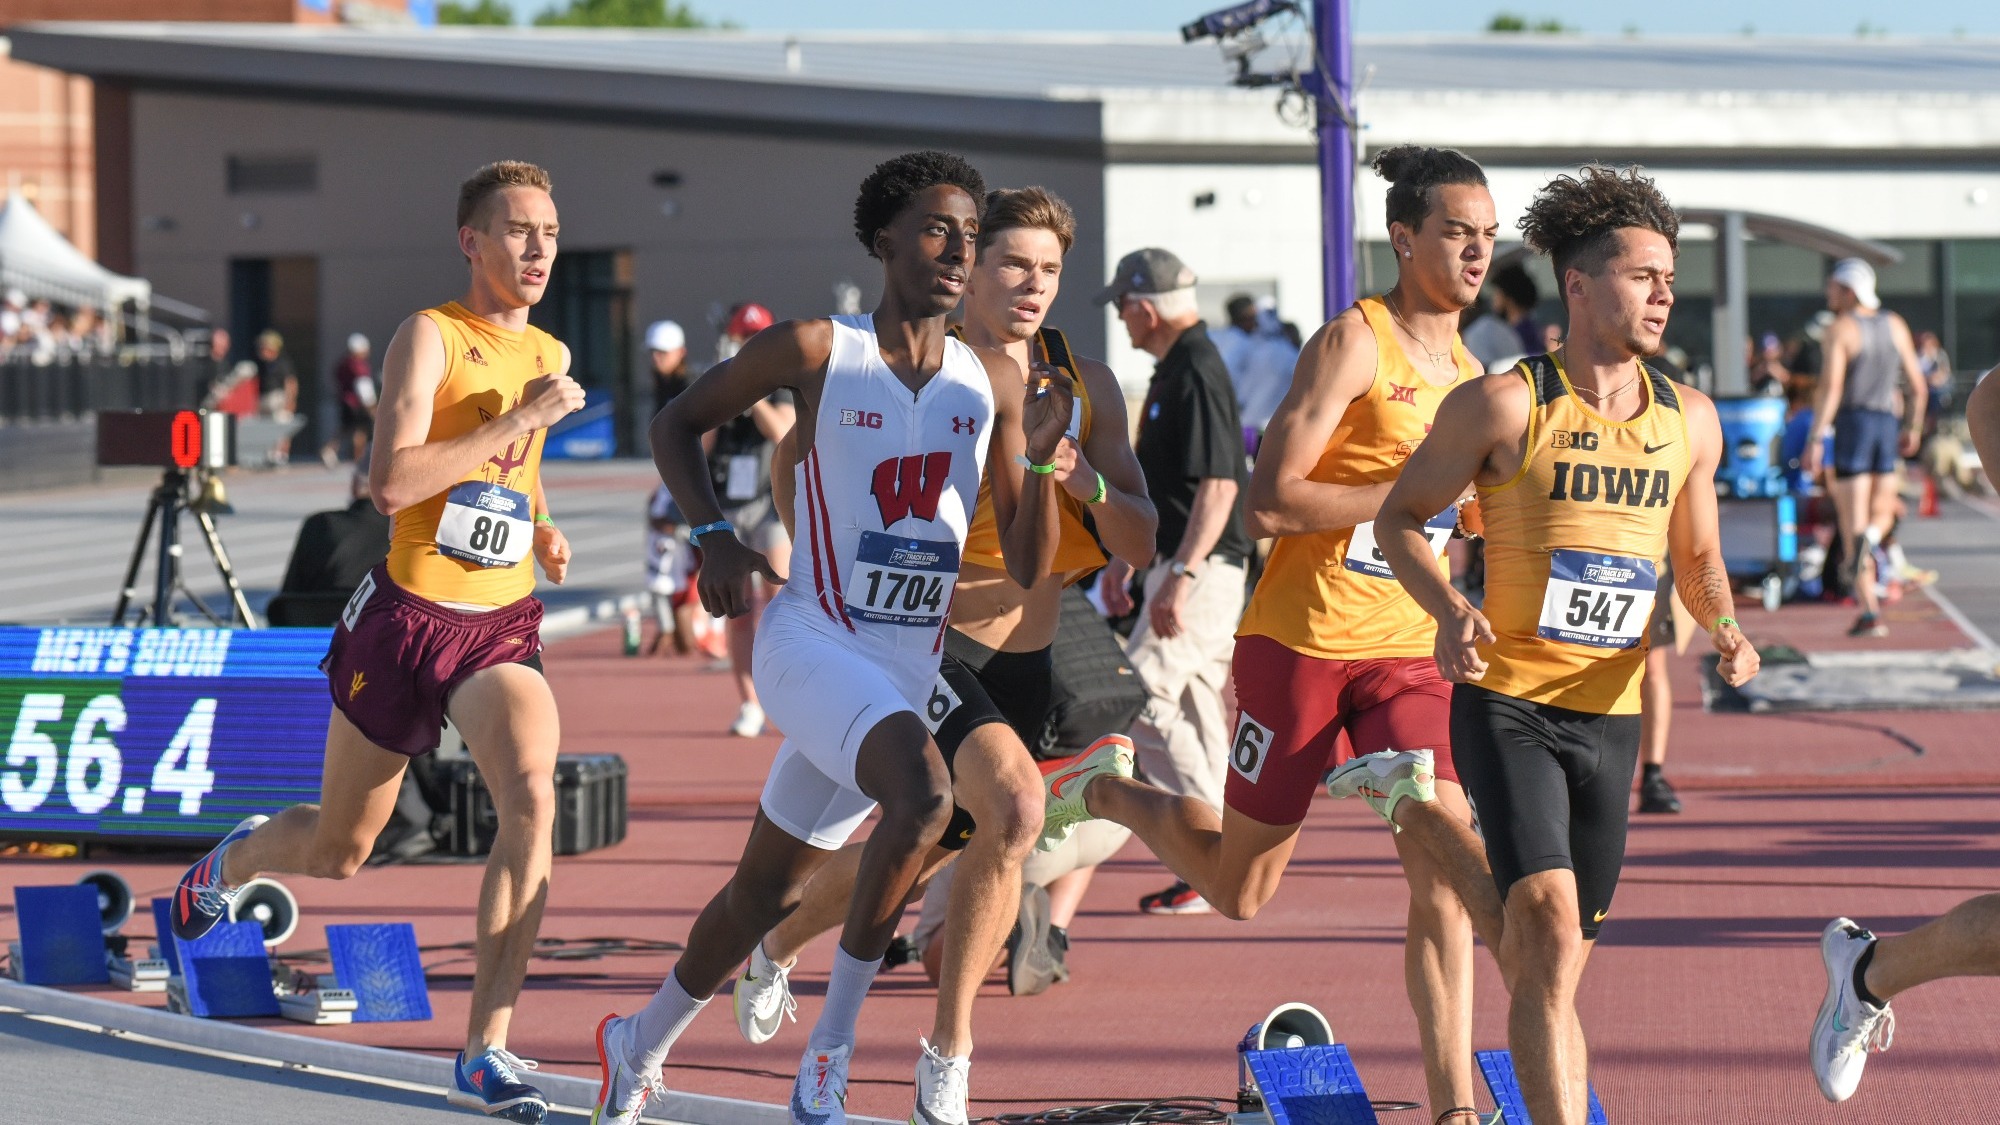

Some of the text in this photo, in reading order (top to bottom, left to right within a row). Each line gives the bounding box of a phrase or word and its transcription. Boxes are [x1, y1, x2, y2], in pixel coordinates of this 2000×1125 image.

[171, 410, 201, 469] 0
[869, 451, 953, 532] W
[1549, 461, 1670, 508] IOWA
[469, 515, 510, 556] 80
[346, 579, 371, 623] 4
[866, 570, 944, 613] 1704
[1566, 588, 1635, 632] 547
[31, 628, 135, 673] MEN'S
[927, 683, 951, 723] 6
[0, 693, 218, 816] 56.4
[1234, 721, 1264, 774] 6
